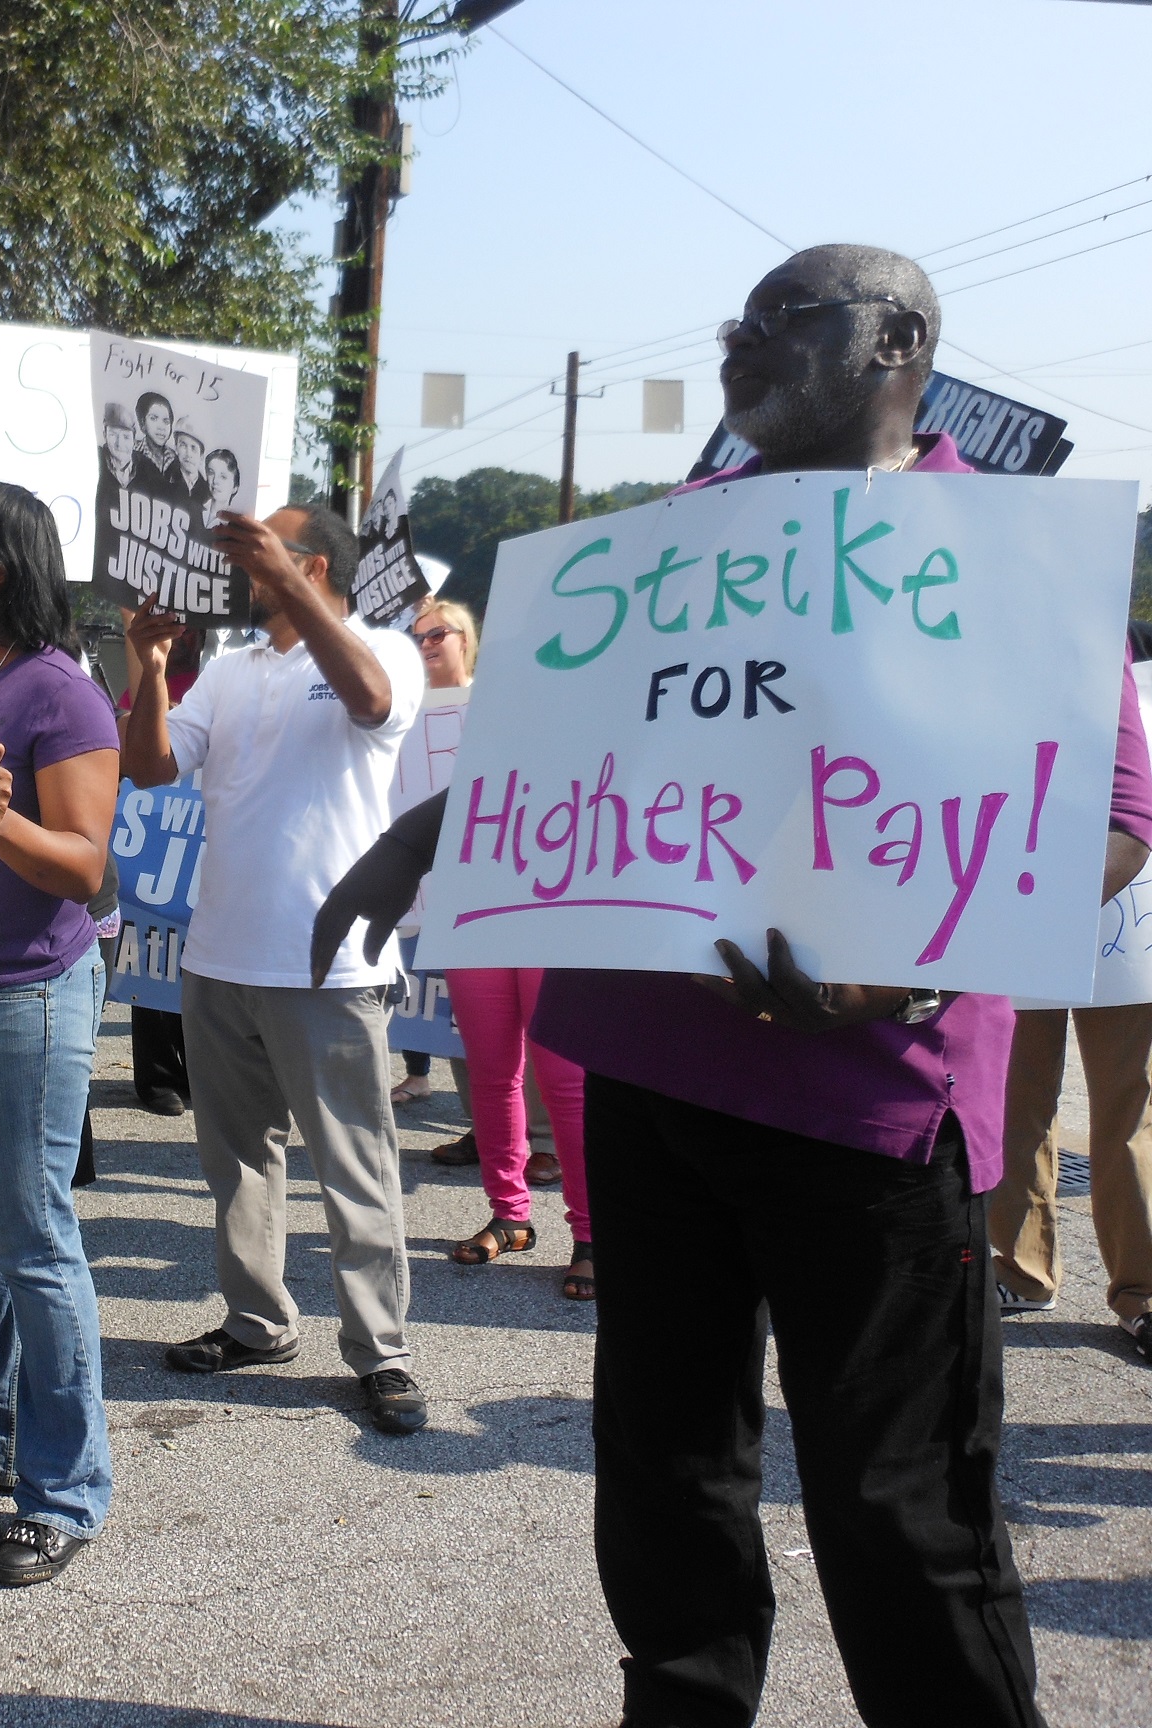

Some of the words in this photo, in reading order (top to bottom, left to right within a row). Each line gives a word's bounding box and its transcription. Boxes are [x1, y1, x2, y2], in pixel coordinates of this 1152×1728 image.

[104, 342, 153, 379] Fight
[164, 362, 188, 384] for
[196, 371, 224, 401] 15
[917, 382, 1046, 472] RIGHTS
[109, 488, 190, 559] JOBS
[108, 535, 231, 615] JUSTICE
[351, 543, 386, 595] JOBS
[356, 556, 416, 620] JUSTICE
[309, 683, 329, 692] JOBS
[645, 659, 796, 722] FOR
[811, 741, 1059, 966] Pay!
